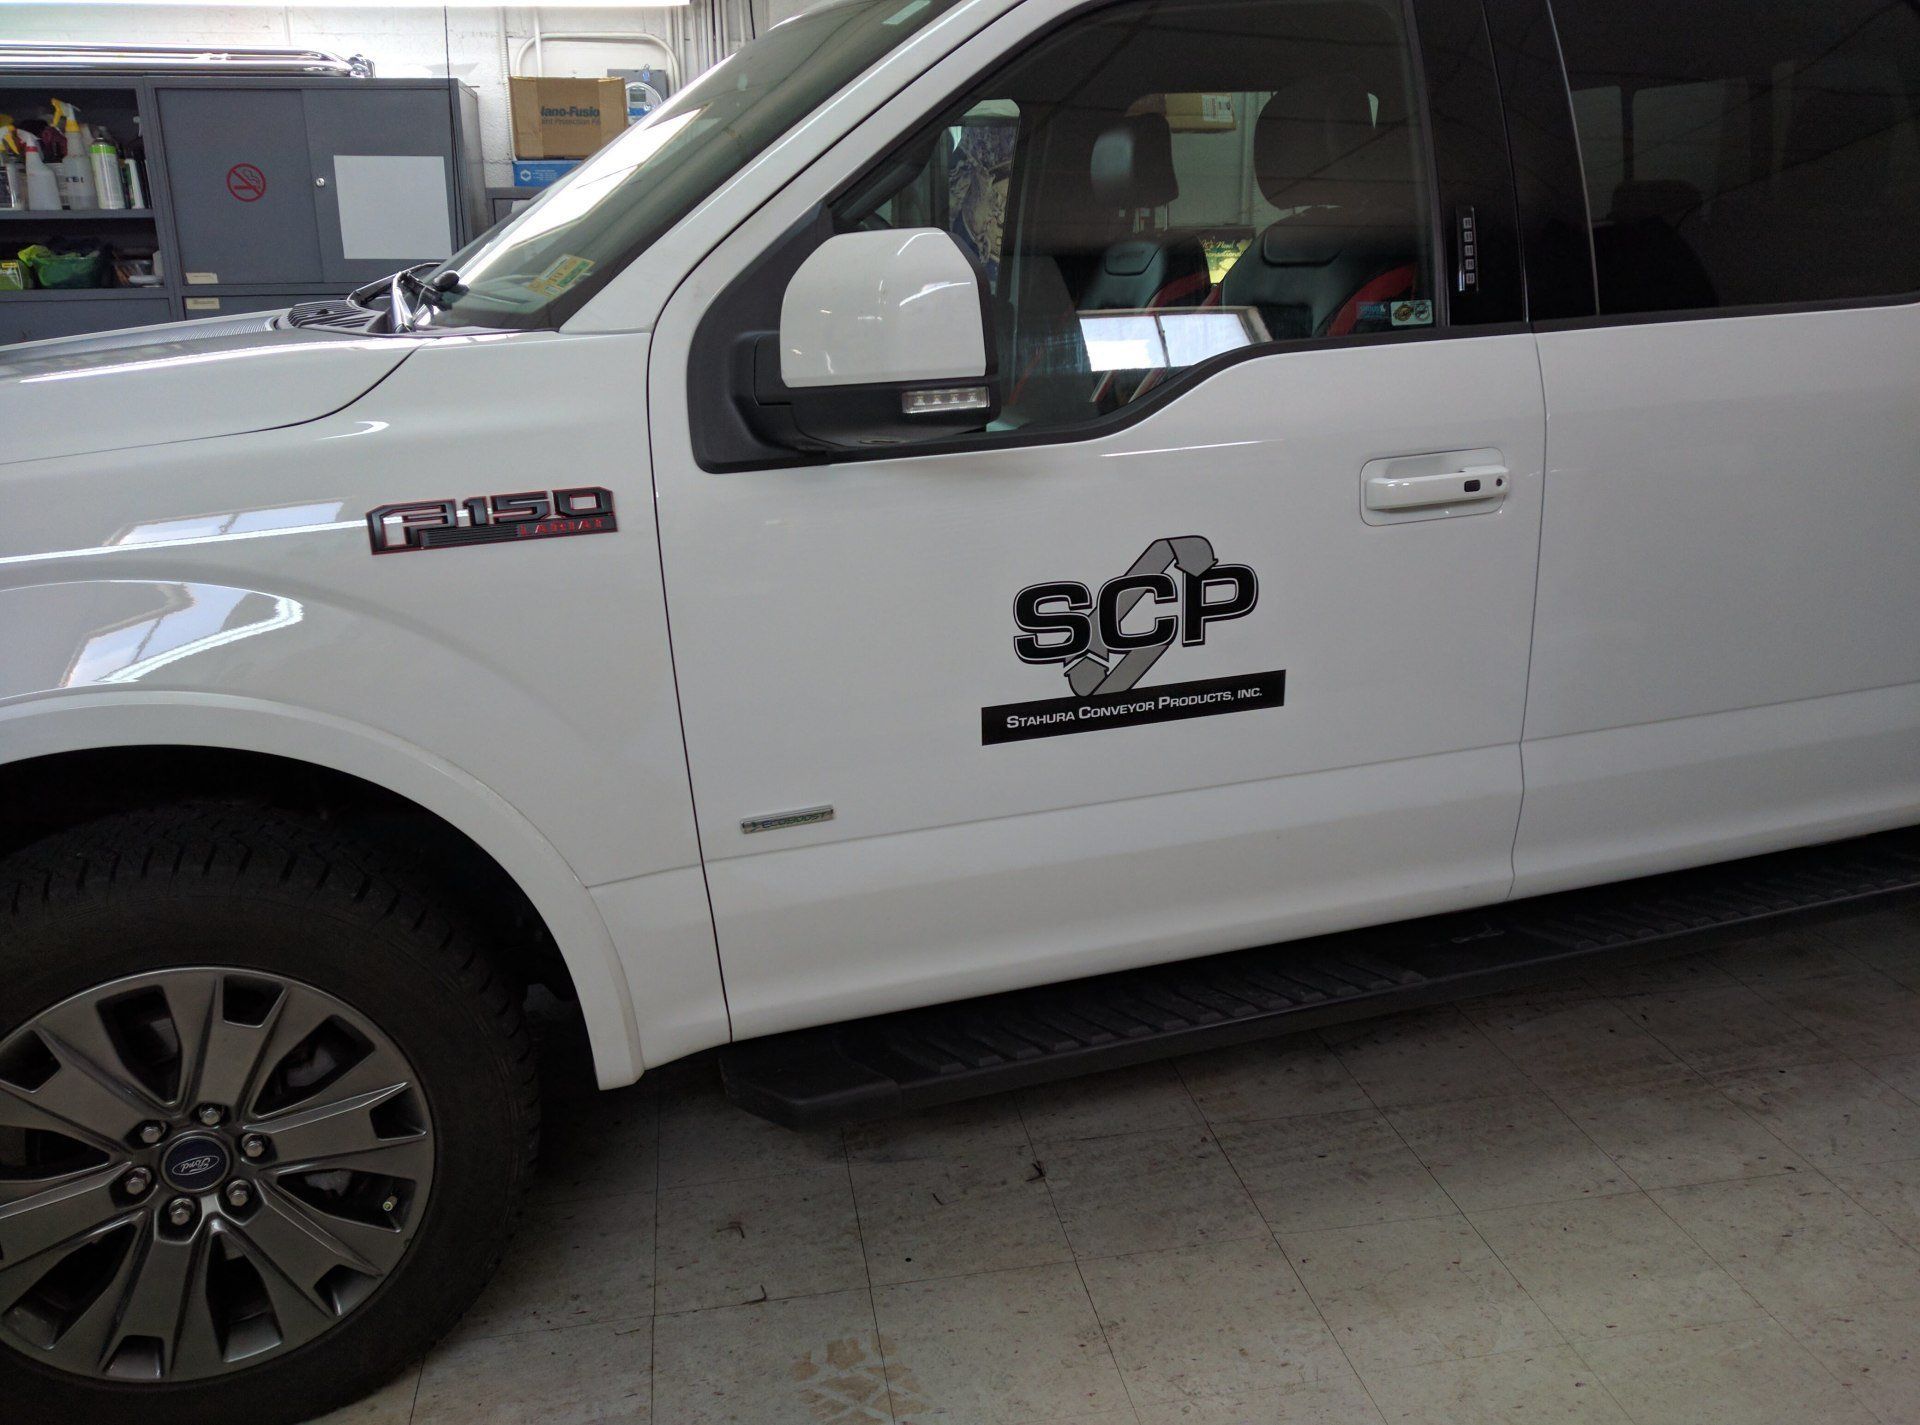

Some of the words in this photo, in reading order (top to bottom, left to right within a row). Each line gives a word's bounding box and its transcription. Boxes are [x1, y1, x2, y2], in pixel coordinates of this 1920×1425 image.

[541, 105, 600, 117] ano-Fusio
[1013, 563, 1259, 665] SCP
[1006, 710, 1076, 729] STAHURA
[1078, 700, 1155, 719] CONVEYOR
[1158, 690, 1235, 709] PRODUCTS,
[1237, 687, 1263, 700] INC.
